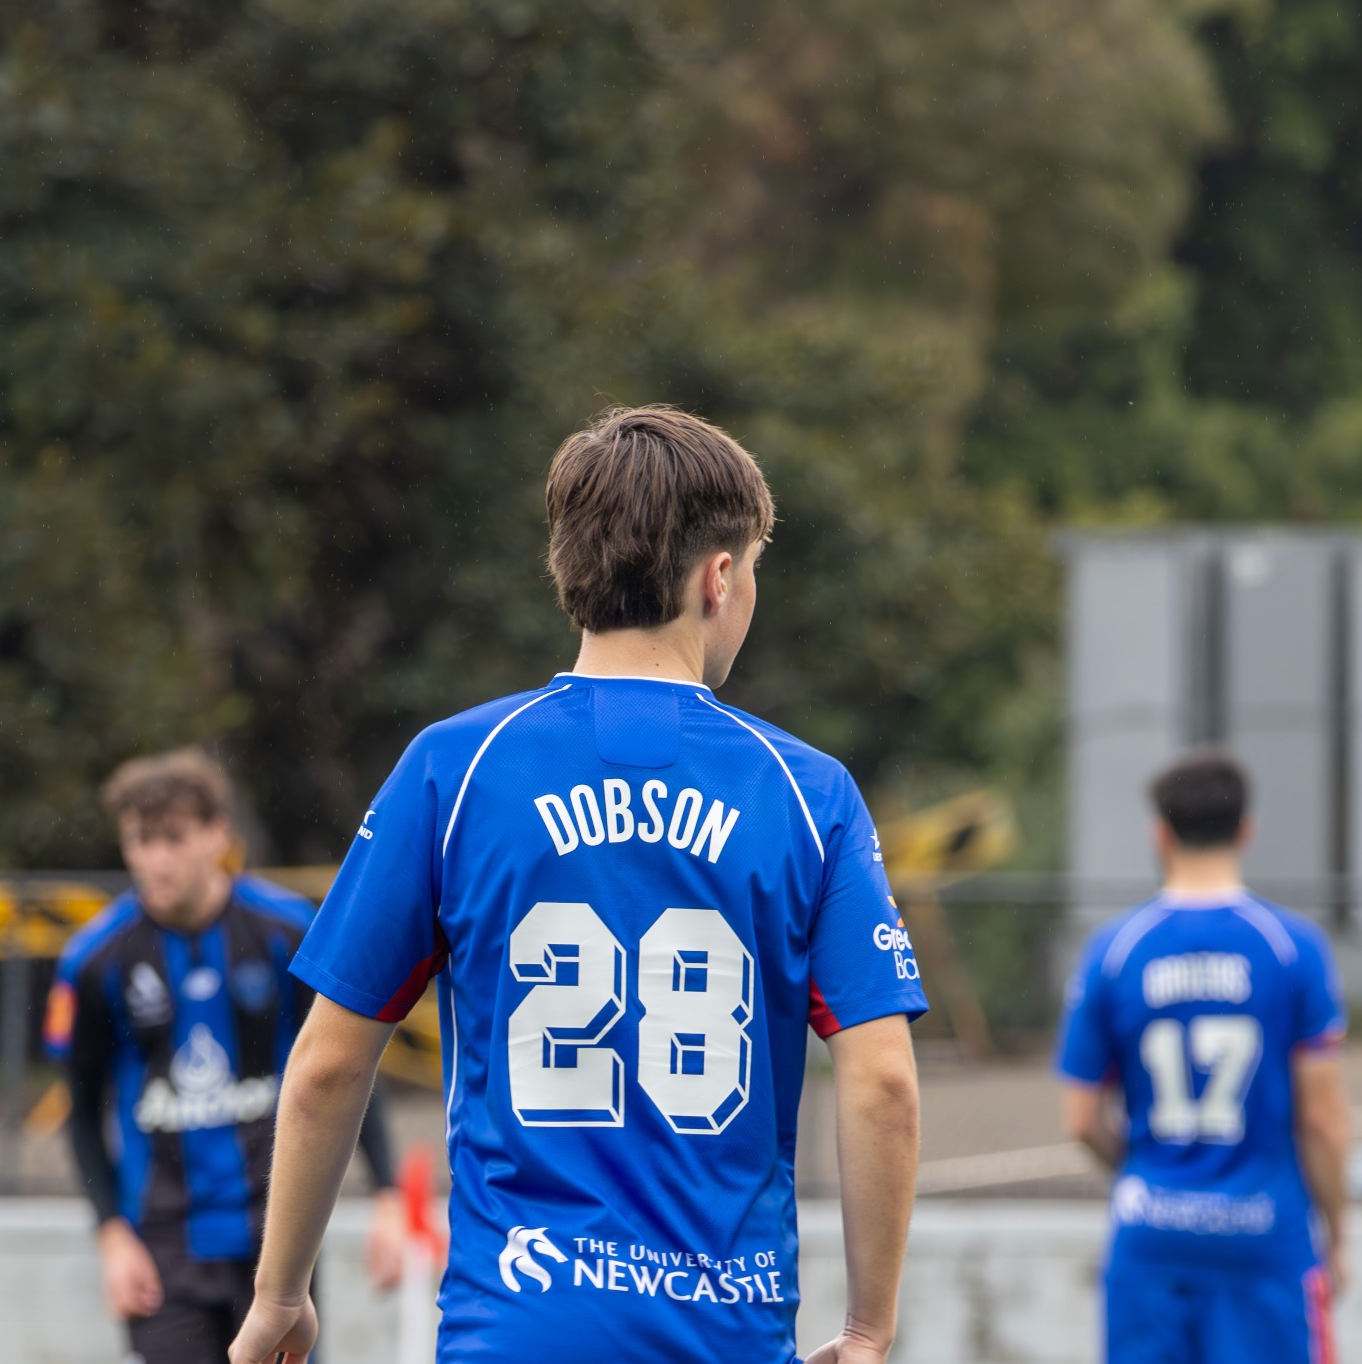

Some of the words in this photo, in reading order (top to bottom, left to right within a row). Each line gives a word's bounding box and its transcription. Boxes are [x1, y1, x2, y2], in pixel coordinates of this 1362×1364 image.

[533, 778, 741, 865] DOBSON
[507, 901, 755, 1136] 28
[1139, 1013, 1265, 1146] 17
[573, 1237, 619, 1257] THE
[754, 1250, 777, 1268] OF
[573, 1258, 785, 1305] NEWCASTLE
